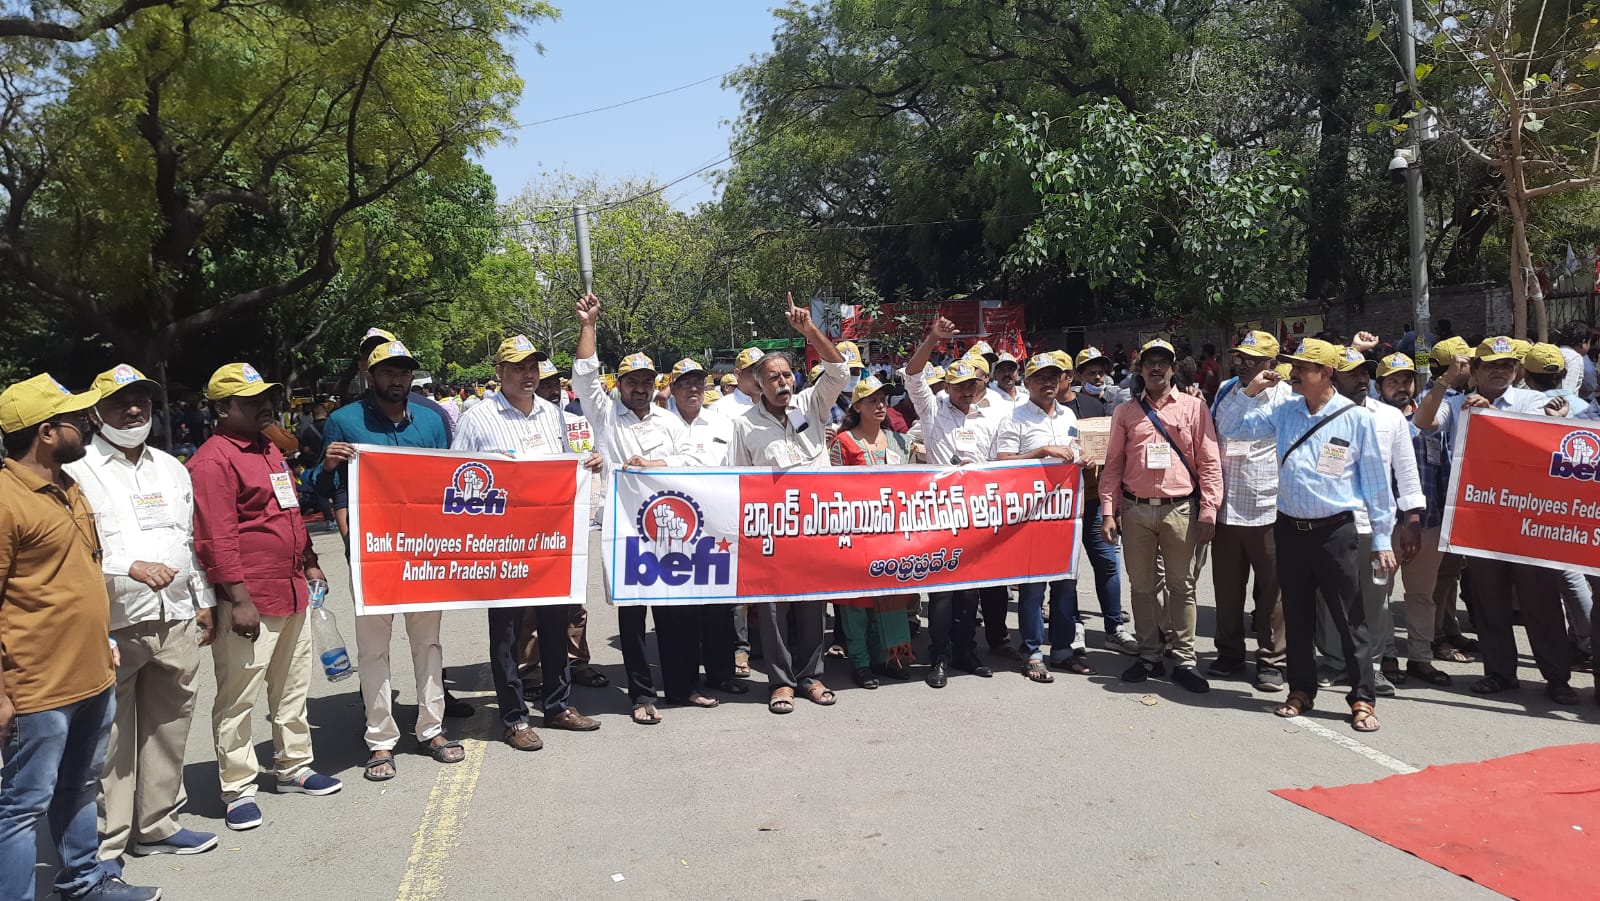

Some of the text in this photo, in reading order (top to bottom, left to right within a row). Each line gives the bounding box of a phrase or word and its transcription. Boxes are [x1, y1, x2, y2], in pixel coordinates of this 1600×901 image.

[443, 487, 506, 514] befi
[1464, 483, 1497, 505] Bank
[1499, 488, 1568, 516] Employees
[744, 488, 800, 555] బ్యాంక్
[970, 482, 1004, 534] ఆఫ్
[1006, 480, 1074, 527] ఇండియా
[1520, 517, 1588, 545] Karnataka
[366, 531, 567, 557] Bank Employees Federation of India
[402, 560, 529, 581] Andhra Pradesh State
[624, 536, 731, 587] befi
[869, 548, 963, 582] ఆంధ్రప్రదేశ్
